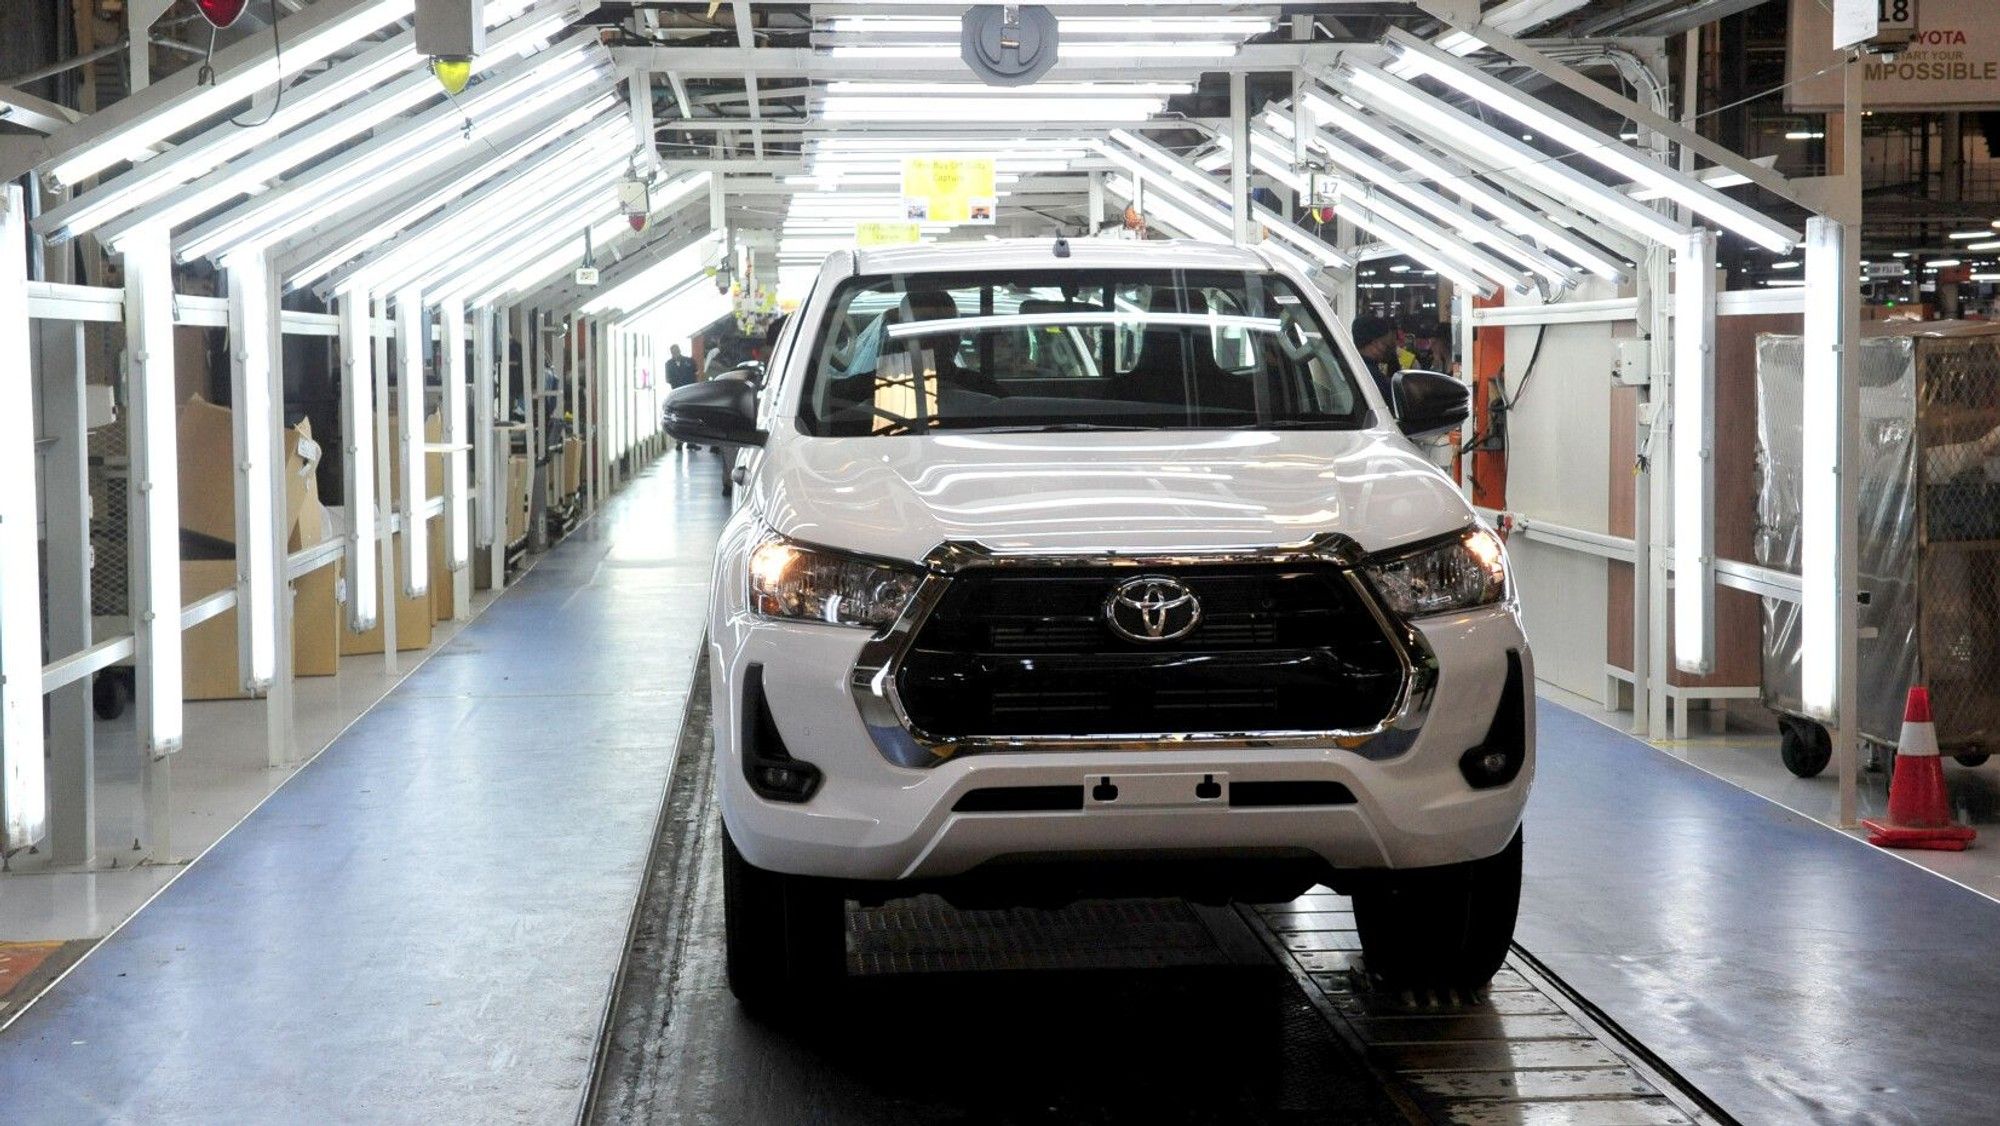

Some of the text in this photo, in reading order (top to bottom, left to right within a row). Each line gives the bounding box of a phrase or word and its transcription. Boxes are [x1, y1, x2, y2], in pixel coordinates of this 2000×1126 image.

[1878, 0, 1909, 22] 18
[1917, 31, 1966, 44] YOTA
[1931, 50, 1964, 61] YOUR
[1864, 62, 1997, 80] MPOSSIBLE
[1322, 182, 1338, 194] 17
